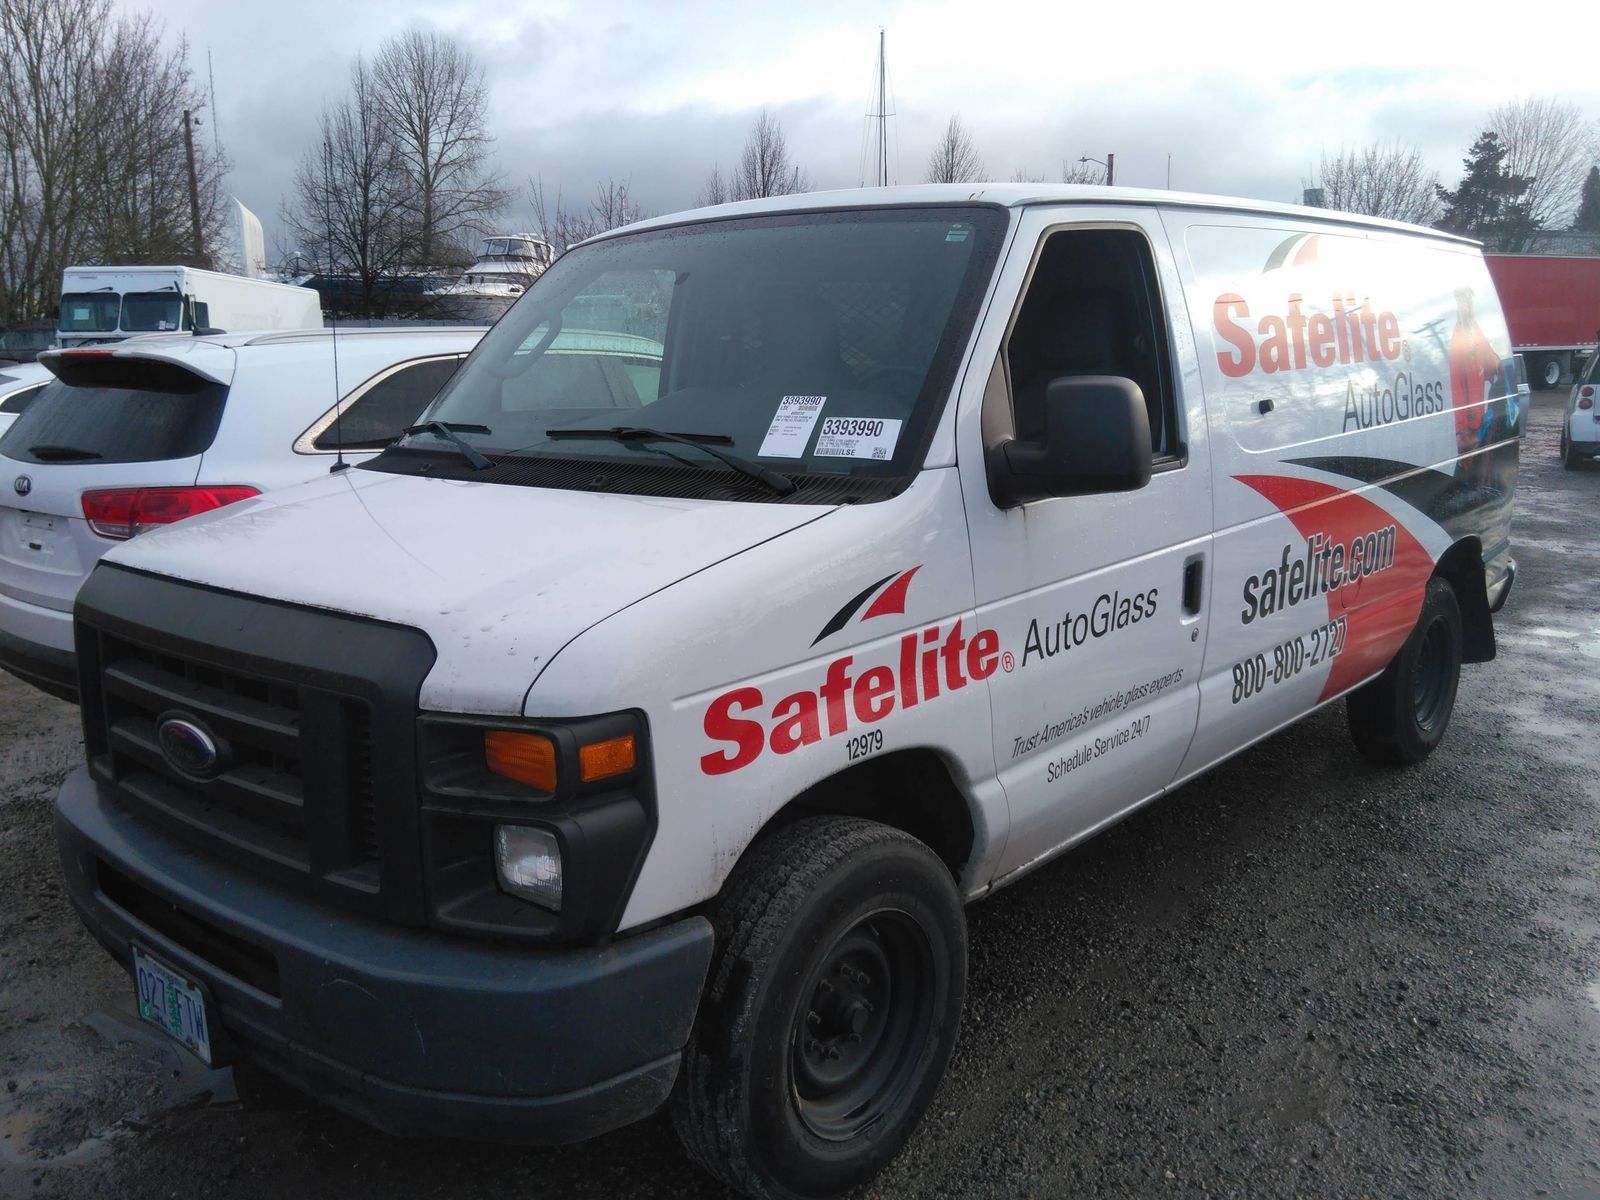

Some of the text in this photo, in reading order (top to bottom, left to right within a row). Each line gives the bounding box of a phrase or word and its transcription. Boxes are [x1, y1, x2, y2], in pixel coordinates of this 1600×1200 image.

[1214, 291, 1401, 378] Safelite
[783, 396, 822, 406] 3393990
[823, 420, 884, 437] 3393990
[1342, 371, 1444, 433] AutoGlass
[1241, 525, 1396, 625] safelite.com
[700, 587, 1159, 776] Safelite AutoGlass
[1232, 615, 1347, 704] 800-800-2727
[846, 729, 883, 760] 12979
[1012, 668, 1183, 759] Trust America's vehicle glass experts
[1047, 715, 1150, 783] Schedule Service 24/7
